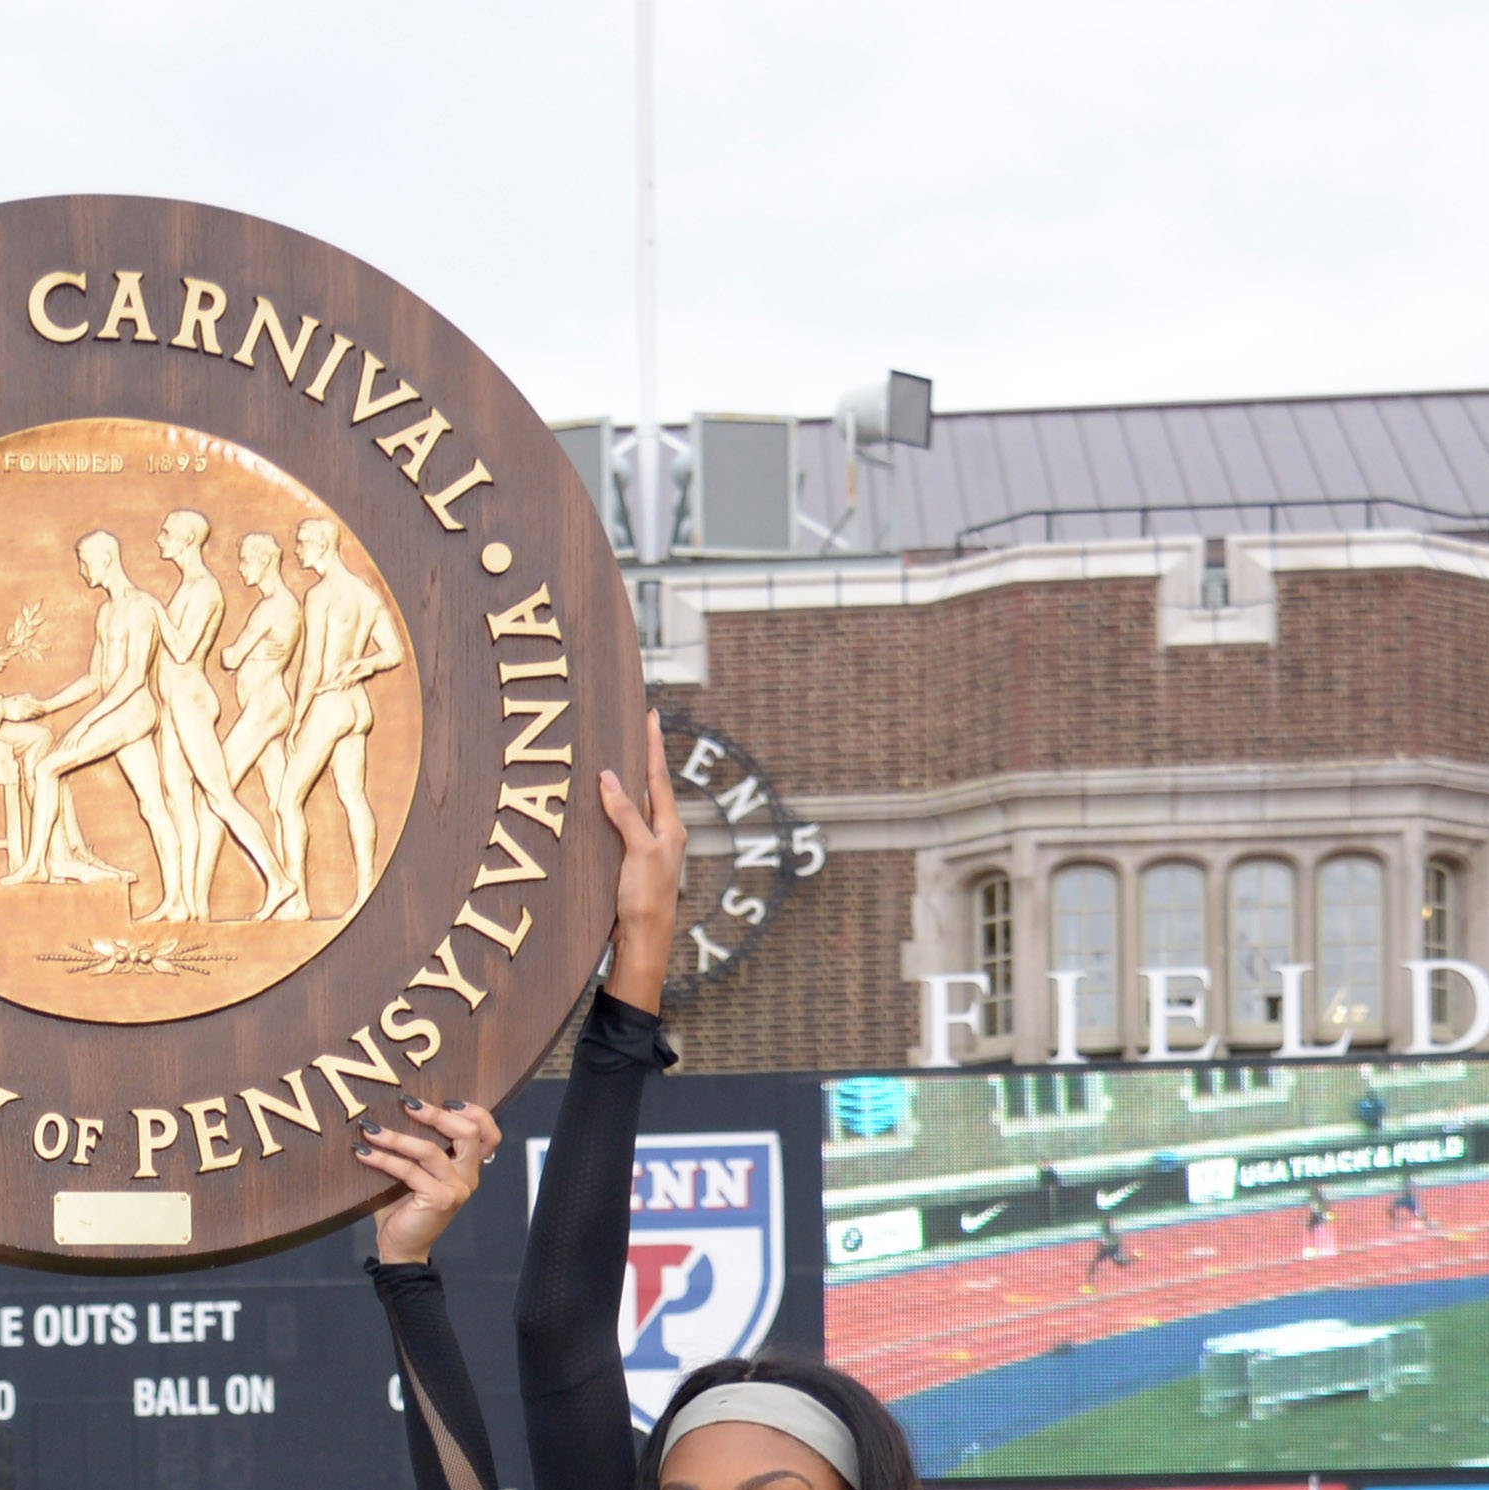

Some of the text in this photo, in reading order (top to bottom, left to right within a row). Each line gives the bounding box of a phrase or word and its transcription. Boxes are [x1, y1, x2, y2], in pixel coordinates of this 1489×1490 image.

[27, 270, 495, 534] CARNIVAL
[3, 453, 208, 474] FOUNDED 1895
[130, 582, 573, 1180] PENNSYLVANIA
[34, 1304, 136, 1346] OUTS
[147, 1301, 242, 1343] LEFT
[133, 1374, 275, 1417] BALL ON
